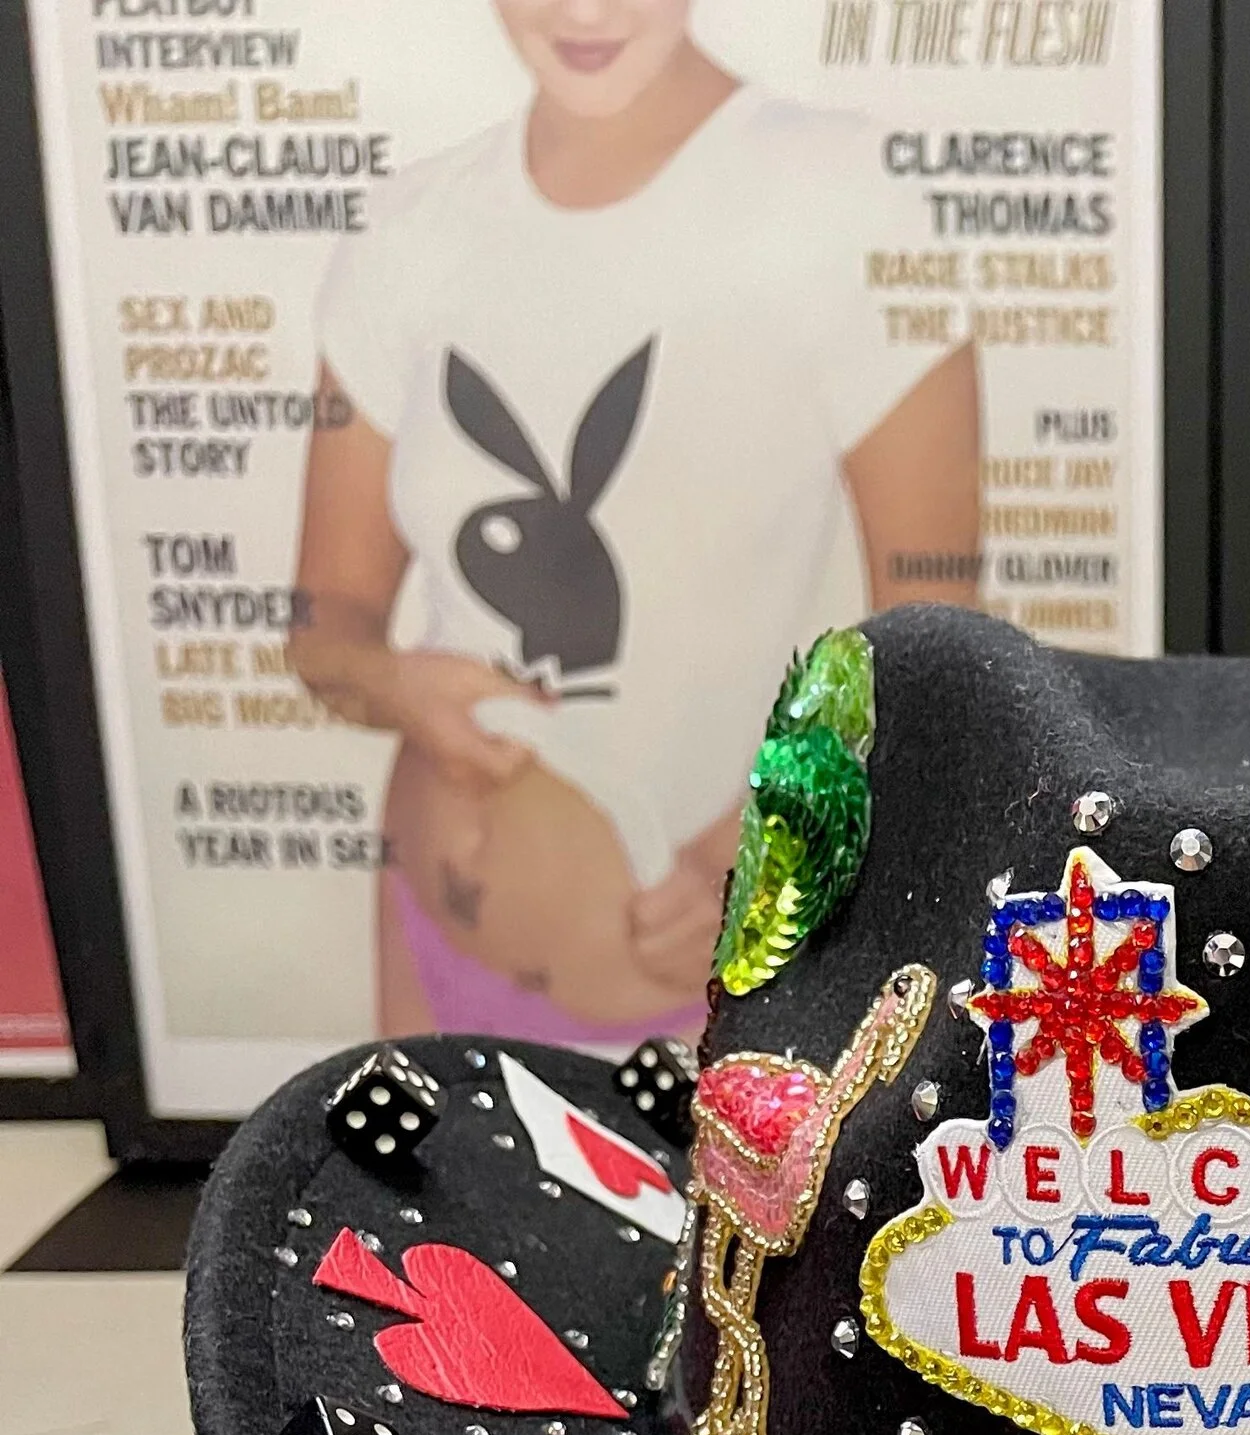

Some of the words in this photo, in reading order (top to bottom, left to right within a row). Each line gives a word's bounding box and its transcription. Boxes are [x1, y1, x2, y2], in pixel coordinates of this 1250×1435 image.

[97, 30, 299, 68] INTERVIEW
[100, 80, 237, 123] Wham!
[256, 79, 358, 122] Bam!
[108, 133, 393, 178] JEAN-CLAUDE
[882, 132, 1113, 177] CLARENCE
[107, 190, 192, 233] VAN
[206, 188, 368, 232] DAMME
[925, 191, 1113, 236] THOMAS
[977, 251, 1112, 289] STALKS
[119, 297, 190, 333] SEX
[200, 296, 276, 332] AND
[882, 305, 950, 343] THE
[966, 305, 1111, 345] JUSTICE
[124, 343, 270, 381] PROZAC
[128, 391, 199, 429] THE
[207, 391, 354, 429] UNTOLD
[1036, 410, 1118, 442] PLUS
[131, 438, 251, 475] STORY
[142, 534, 236, 577] TOM
[996, 554, 1118, 584] GLOVER
[150, 587, 314, 629] SNYDER
[154, 641, 237, 678] LATE
[161, 690, 226, 727] BIG
[175, 780, 199, 818] A
[206, 782, 366, 821] RIOTOUS
[177, 829, 270, 867] YEAR
[280, 830, 319, 867] IN
[328, 831, 398, 869] SEX
[992, 1226, 1056, 1267] TO
[955, 1271, 1134, 1364] LAS
